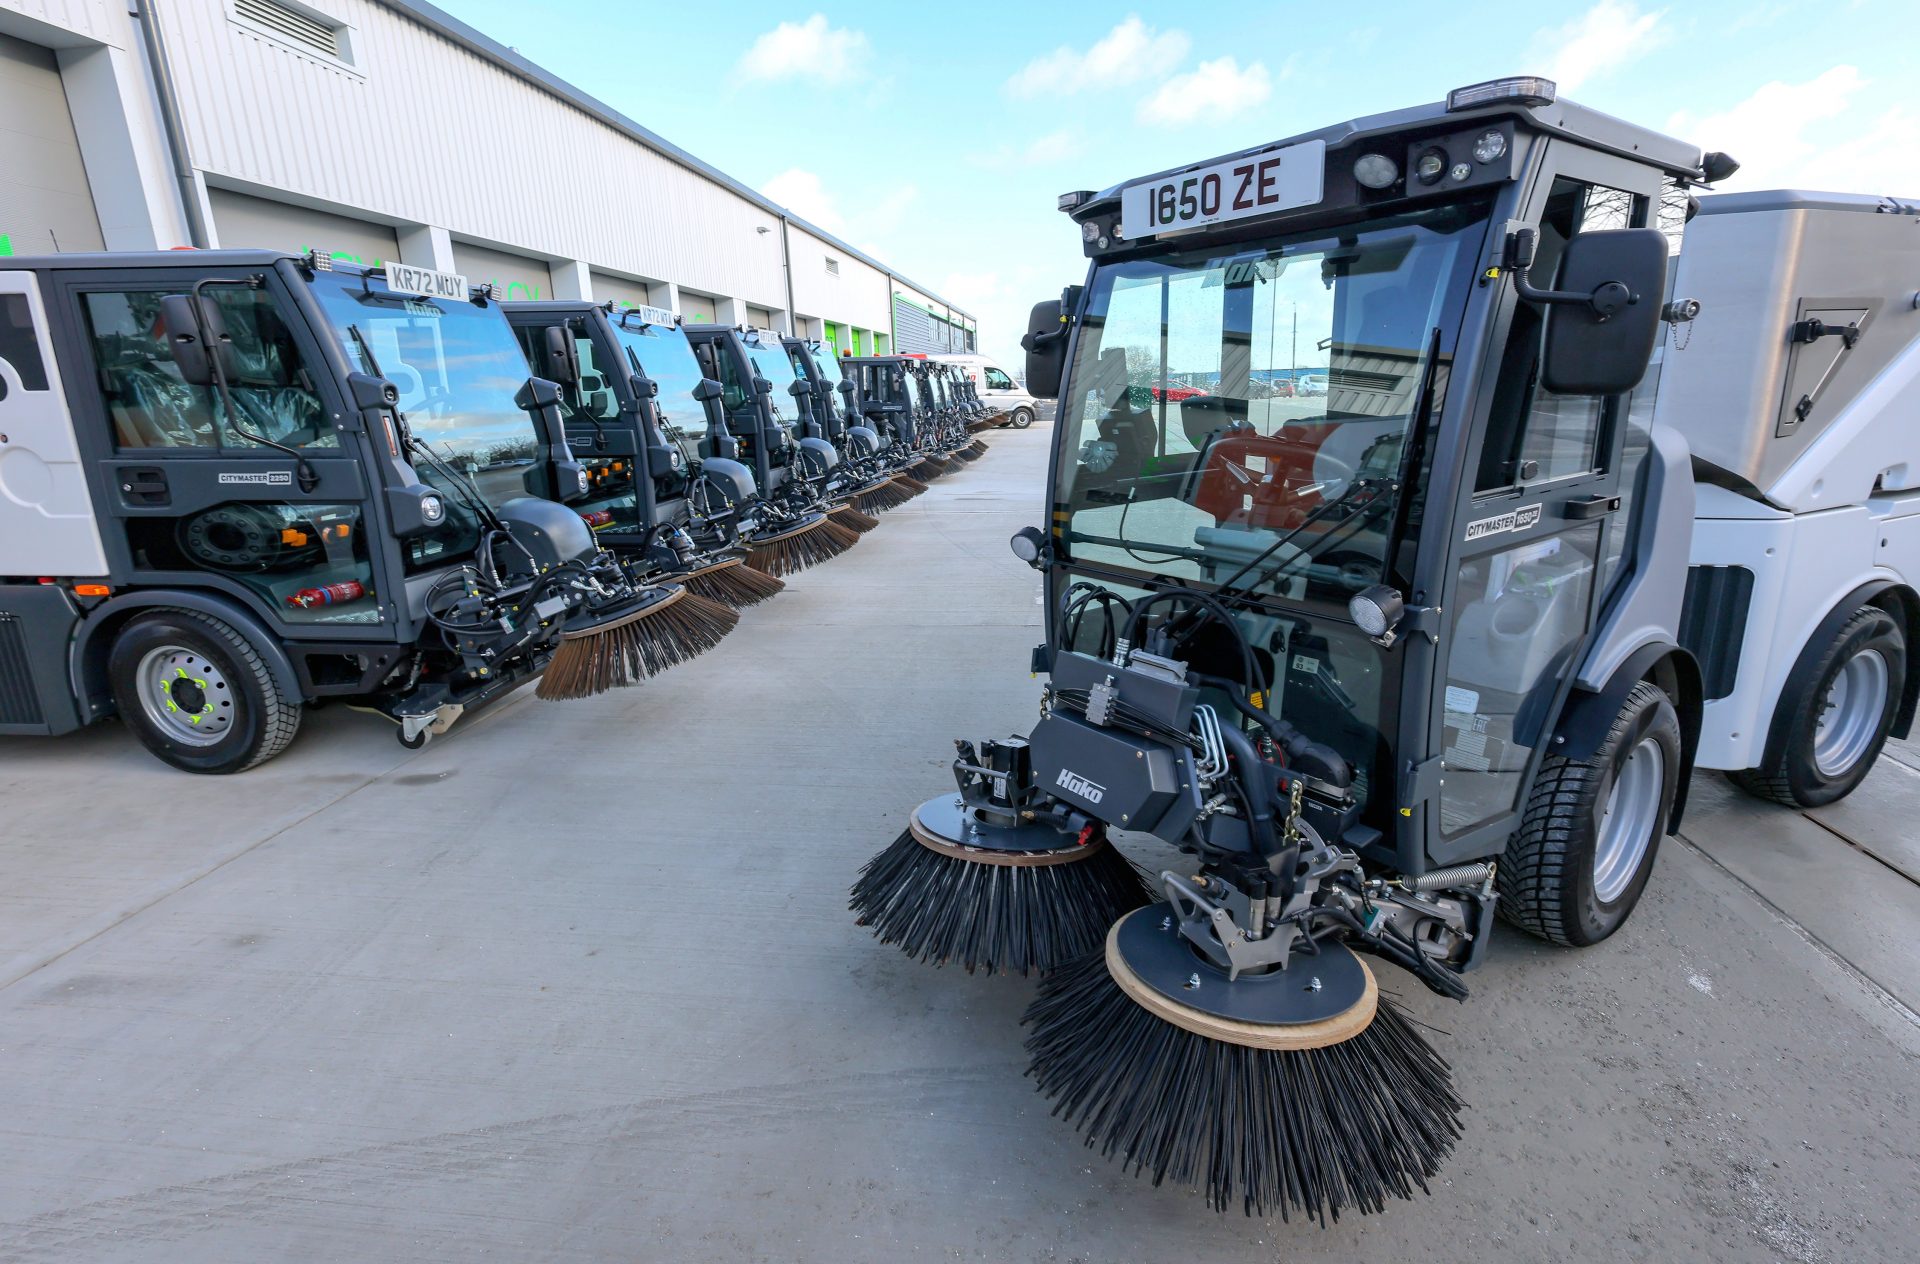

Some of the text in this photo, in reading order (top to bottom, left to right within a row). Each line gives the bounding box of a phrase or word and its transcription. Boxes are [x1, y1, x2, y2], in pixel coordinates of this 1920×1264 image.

[1149, 157, 1281, 228] 1650 ZE
[392, 266, 462, 298] KR72 MUY
[220, 474, 268, 482] CITYMASTER
[1468, 515, 1515, 537] CITYMASTER
[1055, 768, 1107, 804] Hako
